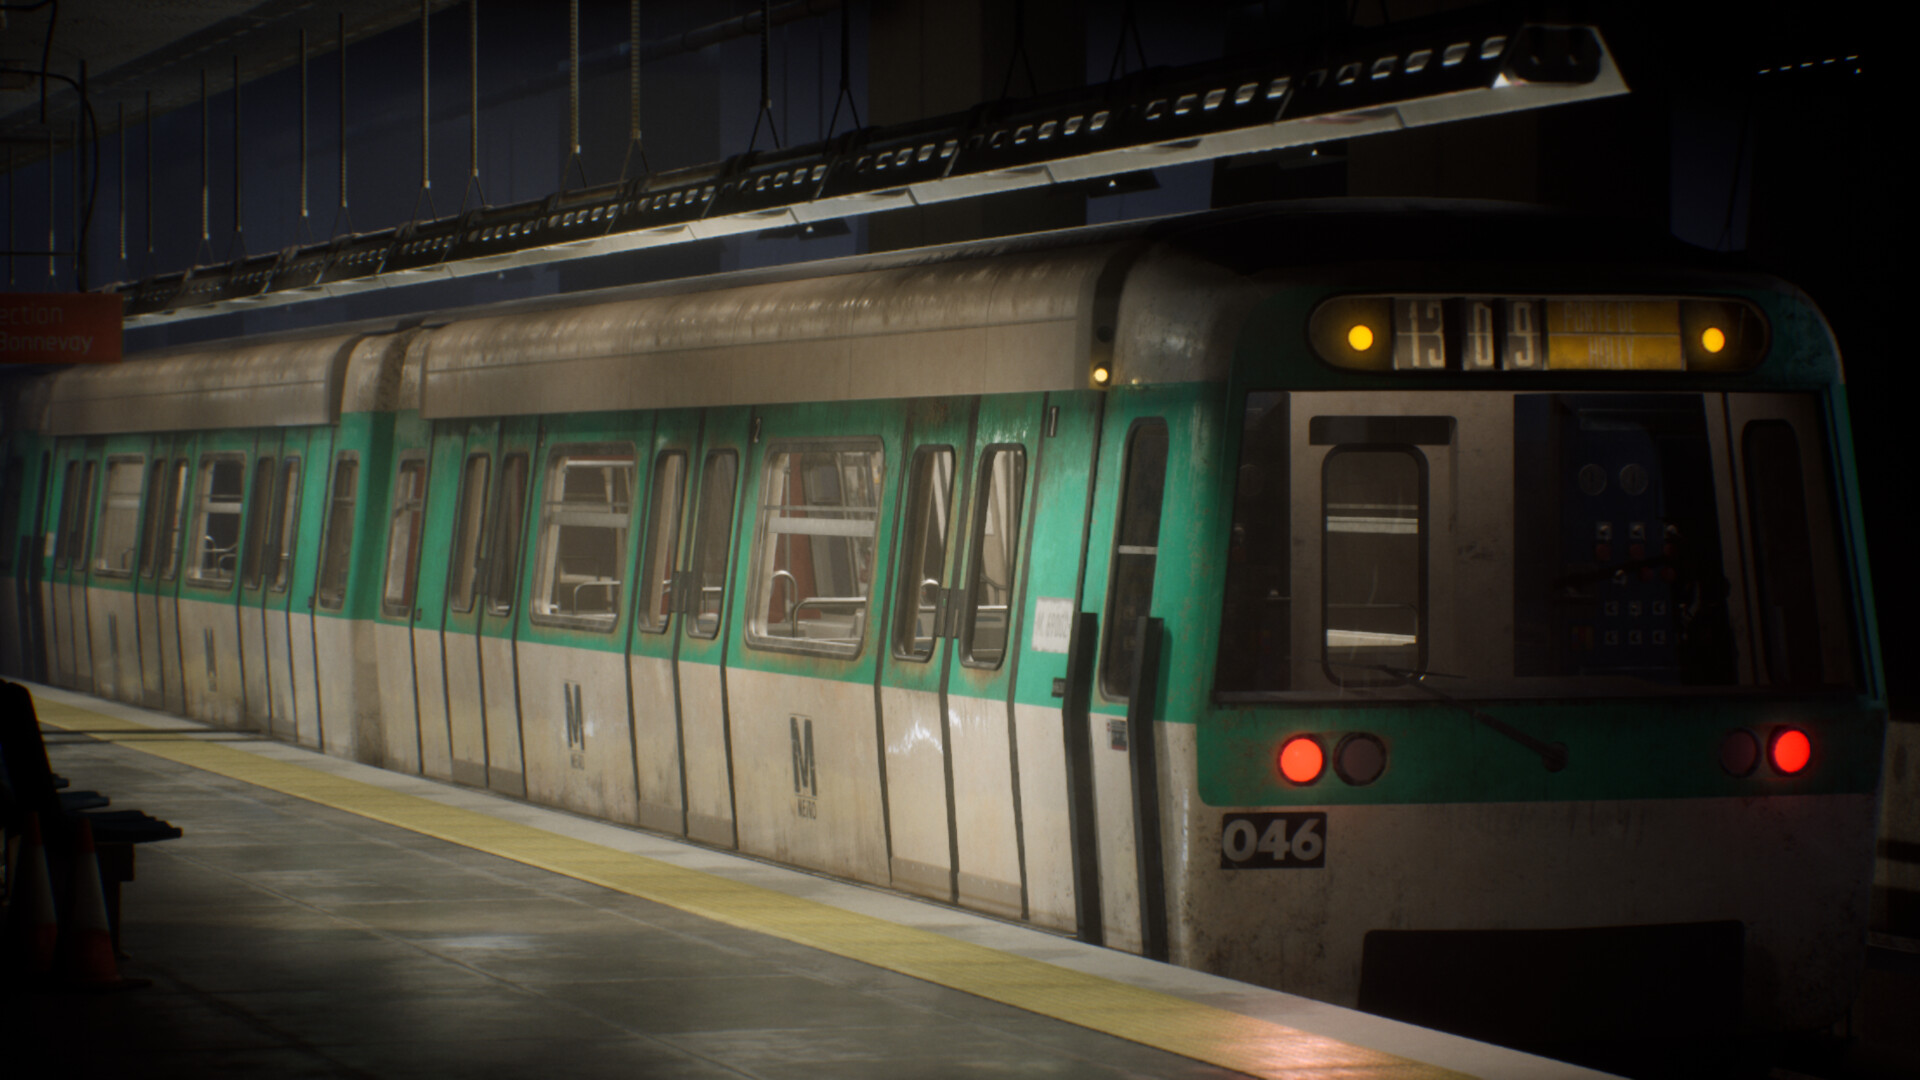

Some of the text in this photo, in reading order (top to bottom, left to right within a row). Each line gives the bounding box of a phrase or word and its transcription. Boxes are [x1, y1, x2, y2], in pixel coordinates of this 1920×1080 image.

[1408, 300, 1447, 368] 13
[564, 683, 585, 751] M
[789, 716, 818, 797] M
[1222, 818, 1323, 862] 046
